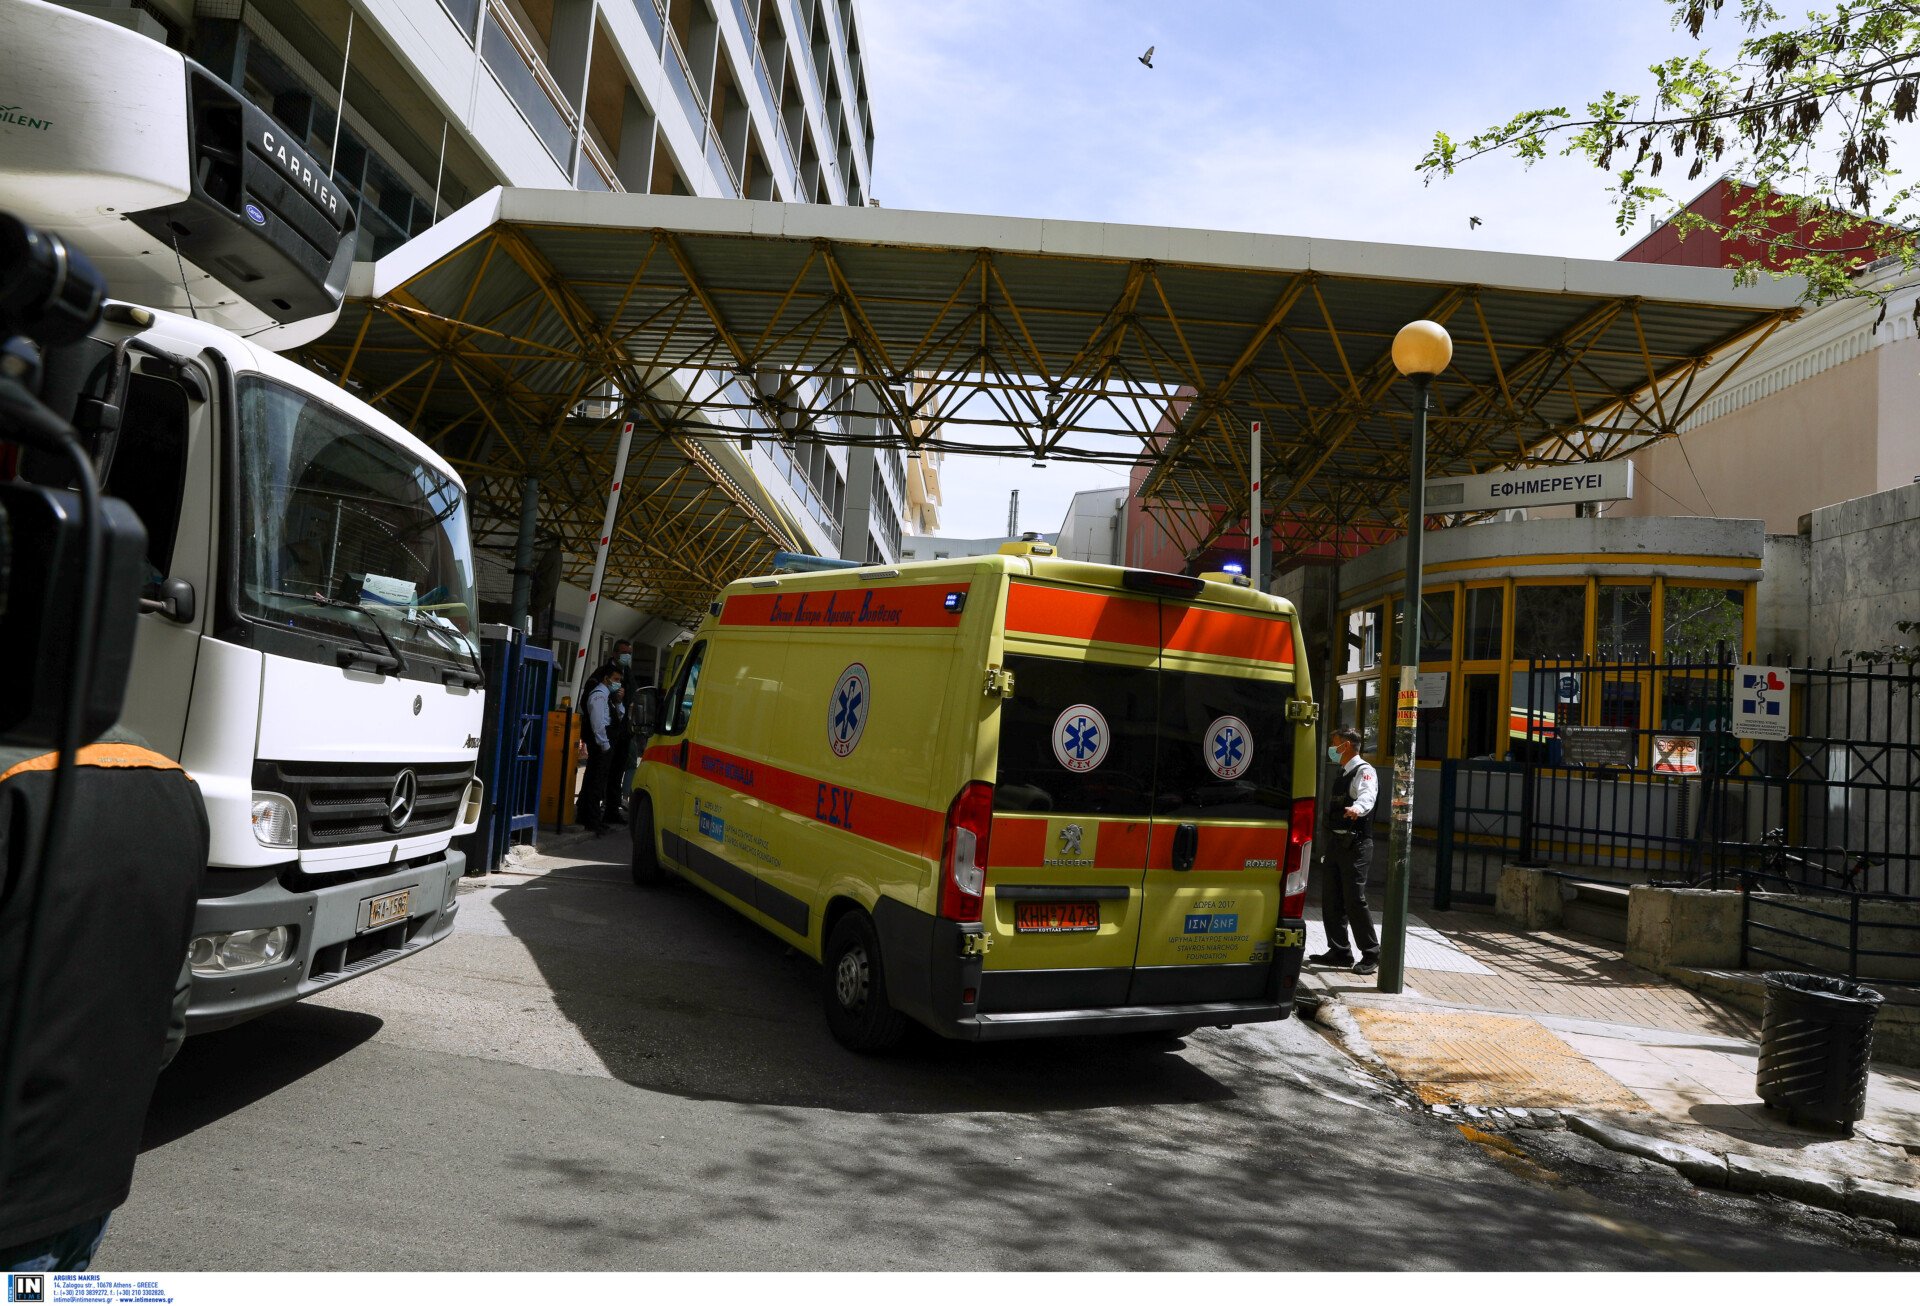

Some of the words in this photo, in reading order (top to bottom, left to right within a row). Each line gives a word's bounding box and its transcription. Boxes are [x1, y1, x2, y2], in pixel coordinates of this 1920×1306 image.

[0, 111, 54, 131] ILENT
[263, 131, 337, 214] CARRIER
[1490, 474, 1602, 497] ΕΦΗΜΕΡΕΥΕΙ
[1193, 901, 1217, 909] ΔΩΡΕΑ
[1218, 901, 1235, 909] 2017
[1213, 918, 1234, 929] SNF
[1186, 952, 1228, 960] FOUNDATION
